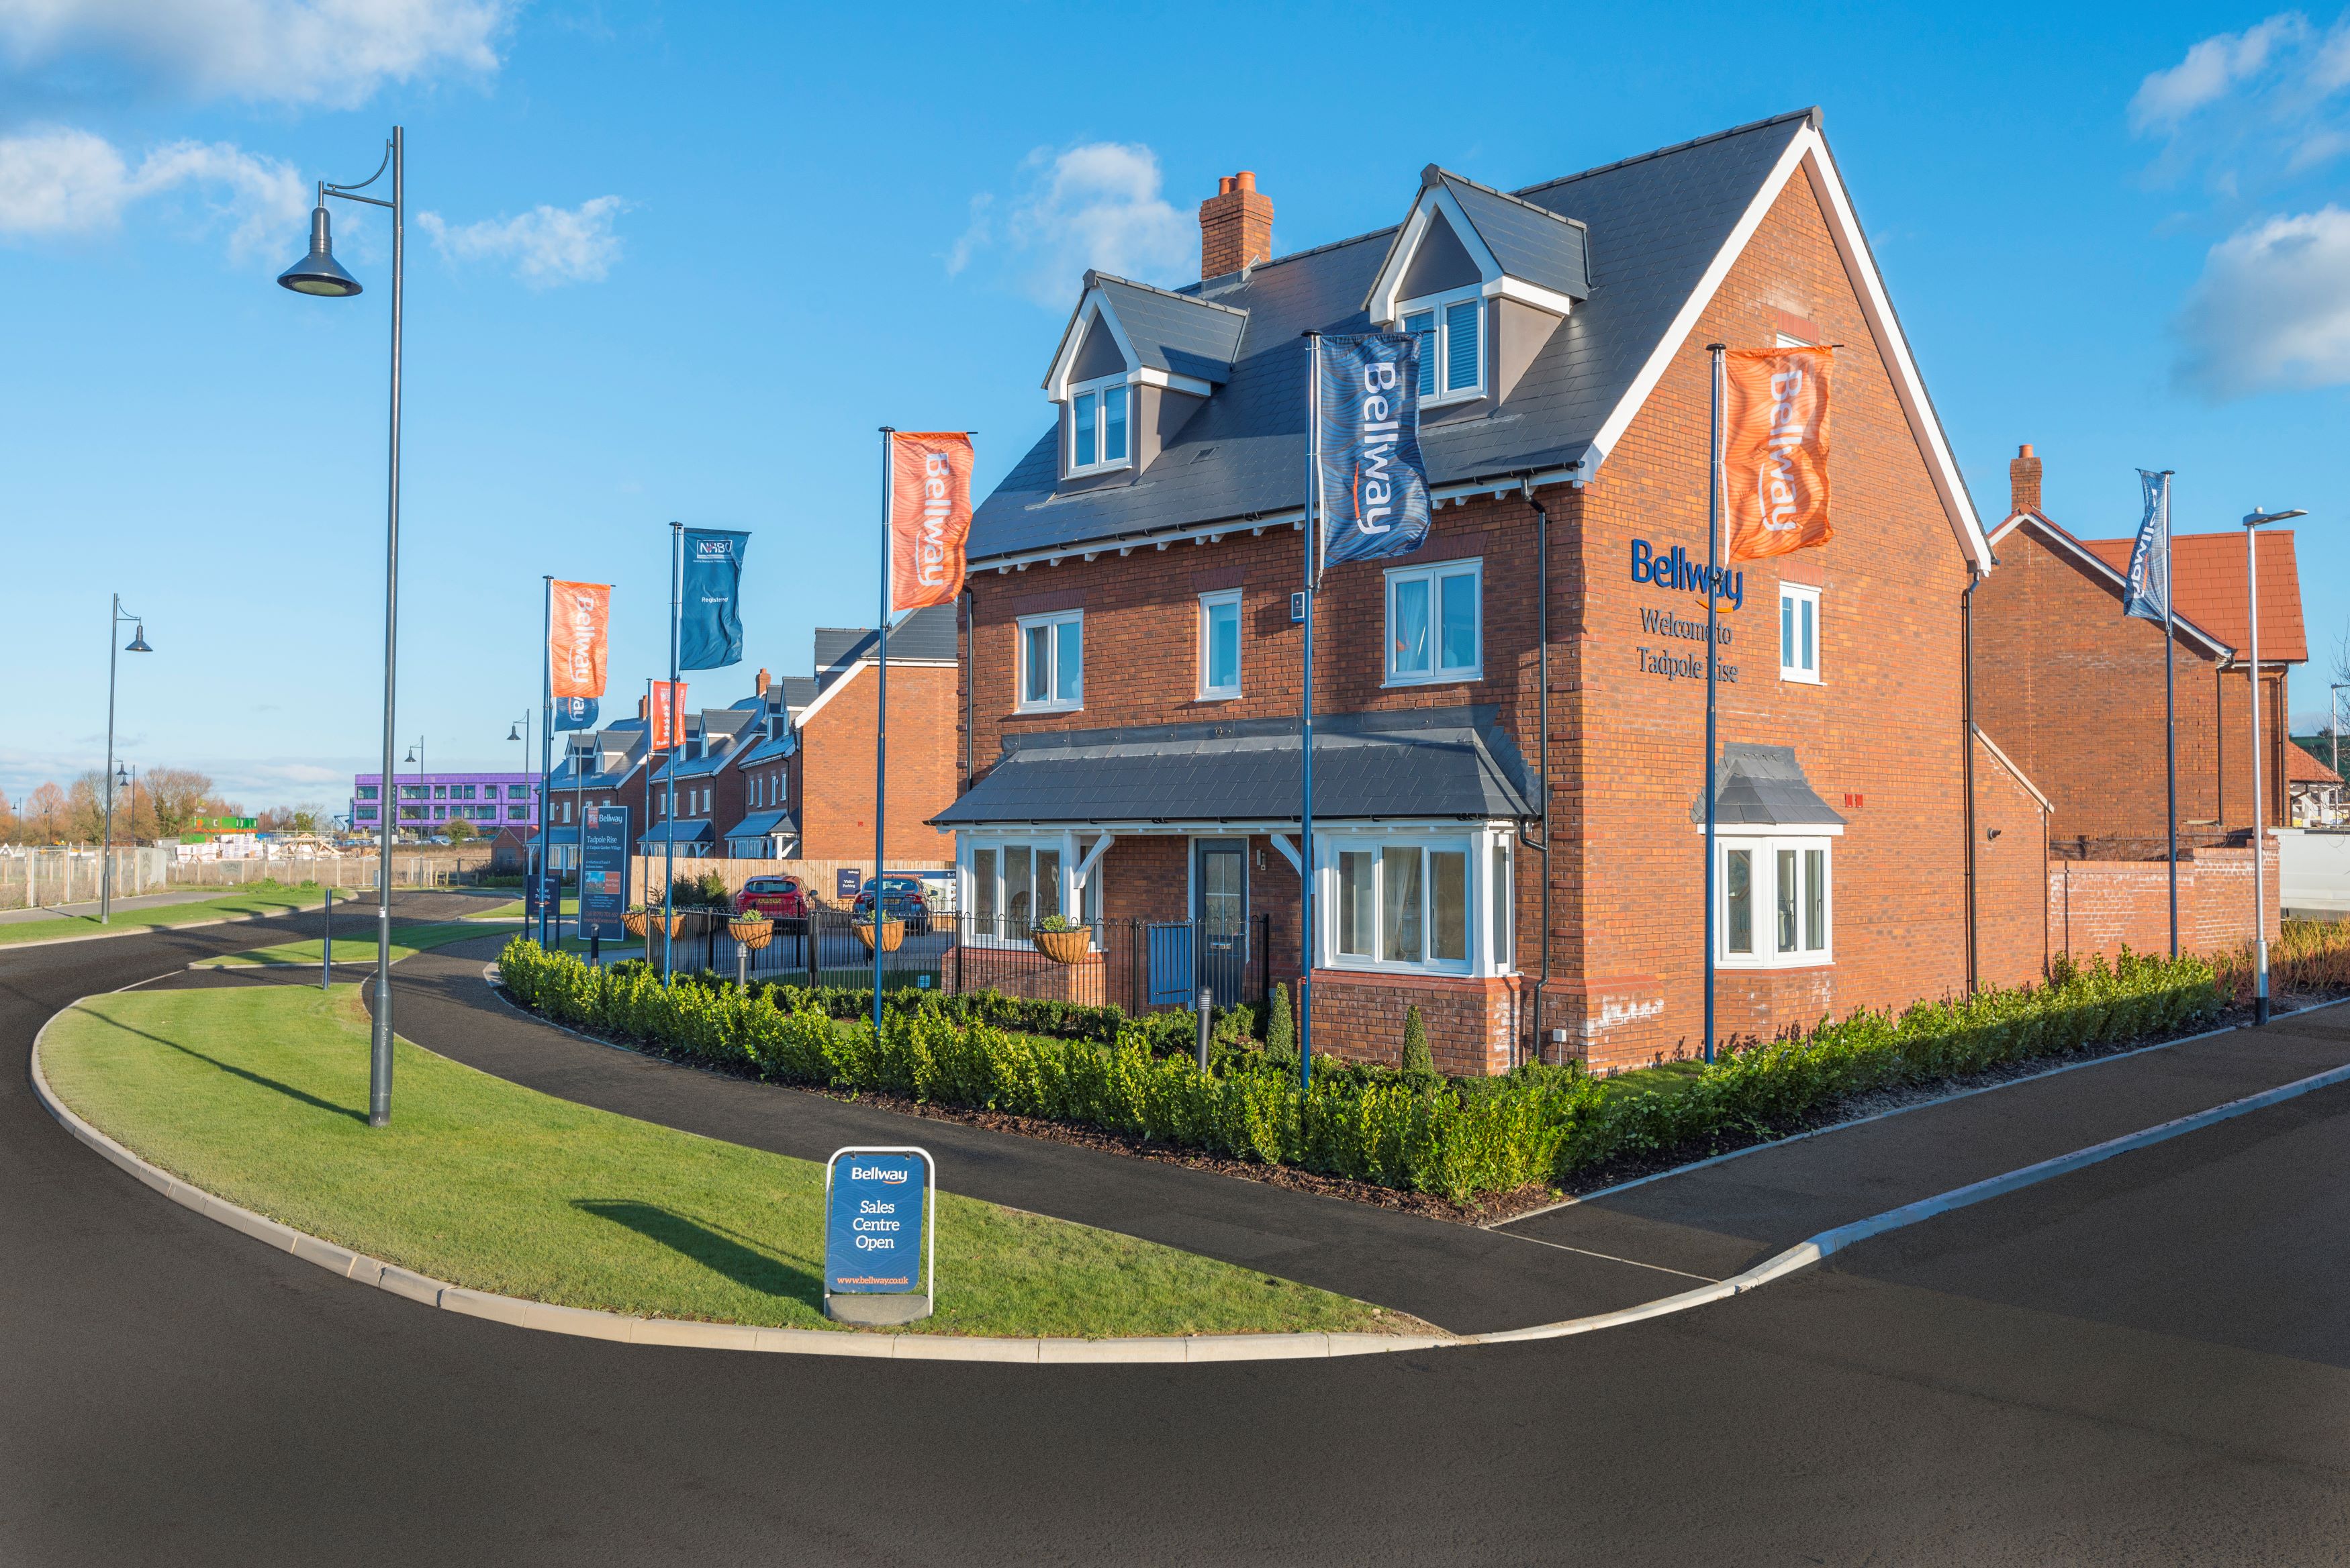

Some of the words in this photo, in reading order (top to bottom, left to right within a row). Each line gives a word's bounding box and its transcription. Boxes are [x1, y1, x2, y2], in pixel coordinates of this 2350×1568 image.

[1356, 362, 1399, 534] Bellway
[1761, 369, 1804, 532] Bellway
[916, 452, 951, 587] Bellway
[700, 542, 731, 553] NHBC
[569, 596, 596, 683] Bellway
[1716, 621, 1733, 644] to
[1637, 646, 1703, 681] Tadpole
[599, 814, 622, 824] Bellway
[587, 836, 606, 844] Tadpole
[851, 1167, 908, 1184] Bellway
[860, 1200, 895, 1214] Sales
[853, 1218, 900, 1231] Centre
[855, 1235, 895, 1251] Open
[837, 1276, 908, 1286] www.bellway.co.uk
